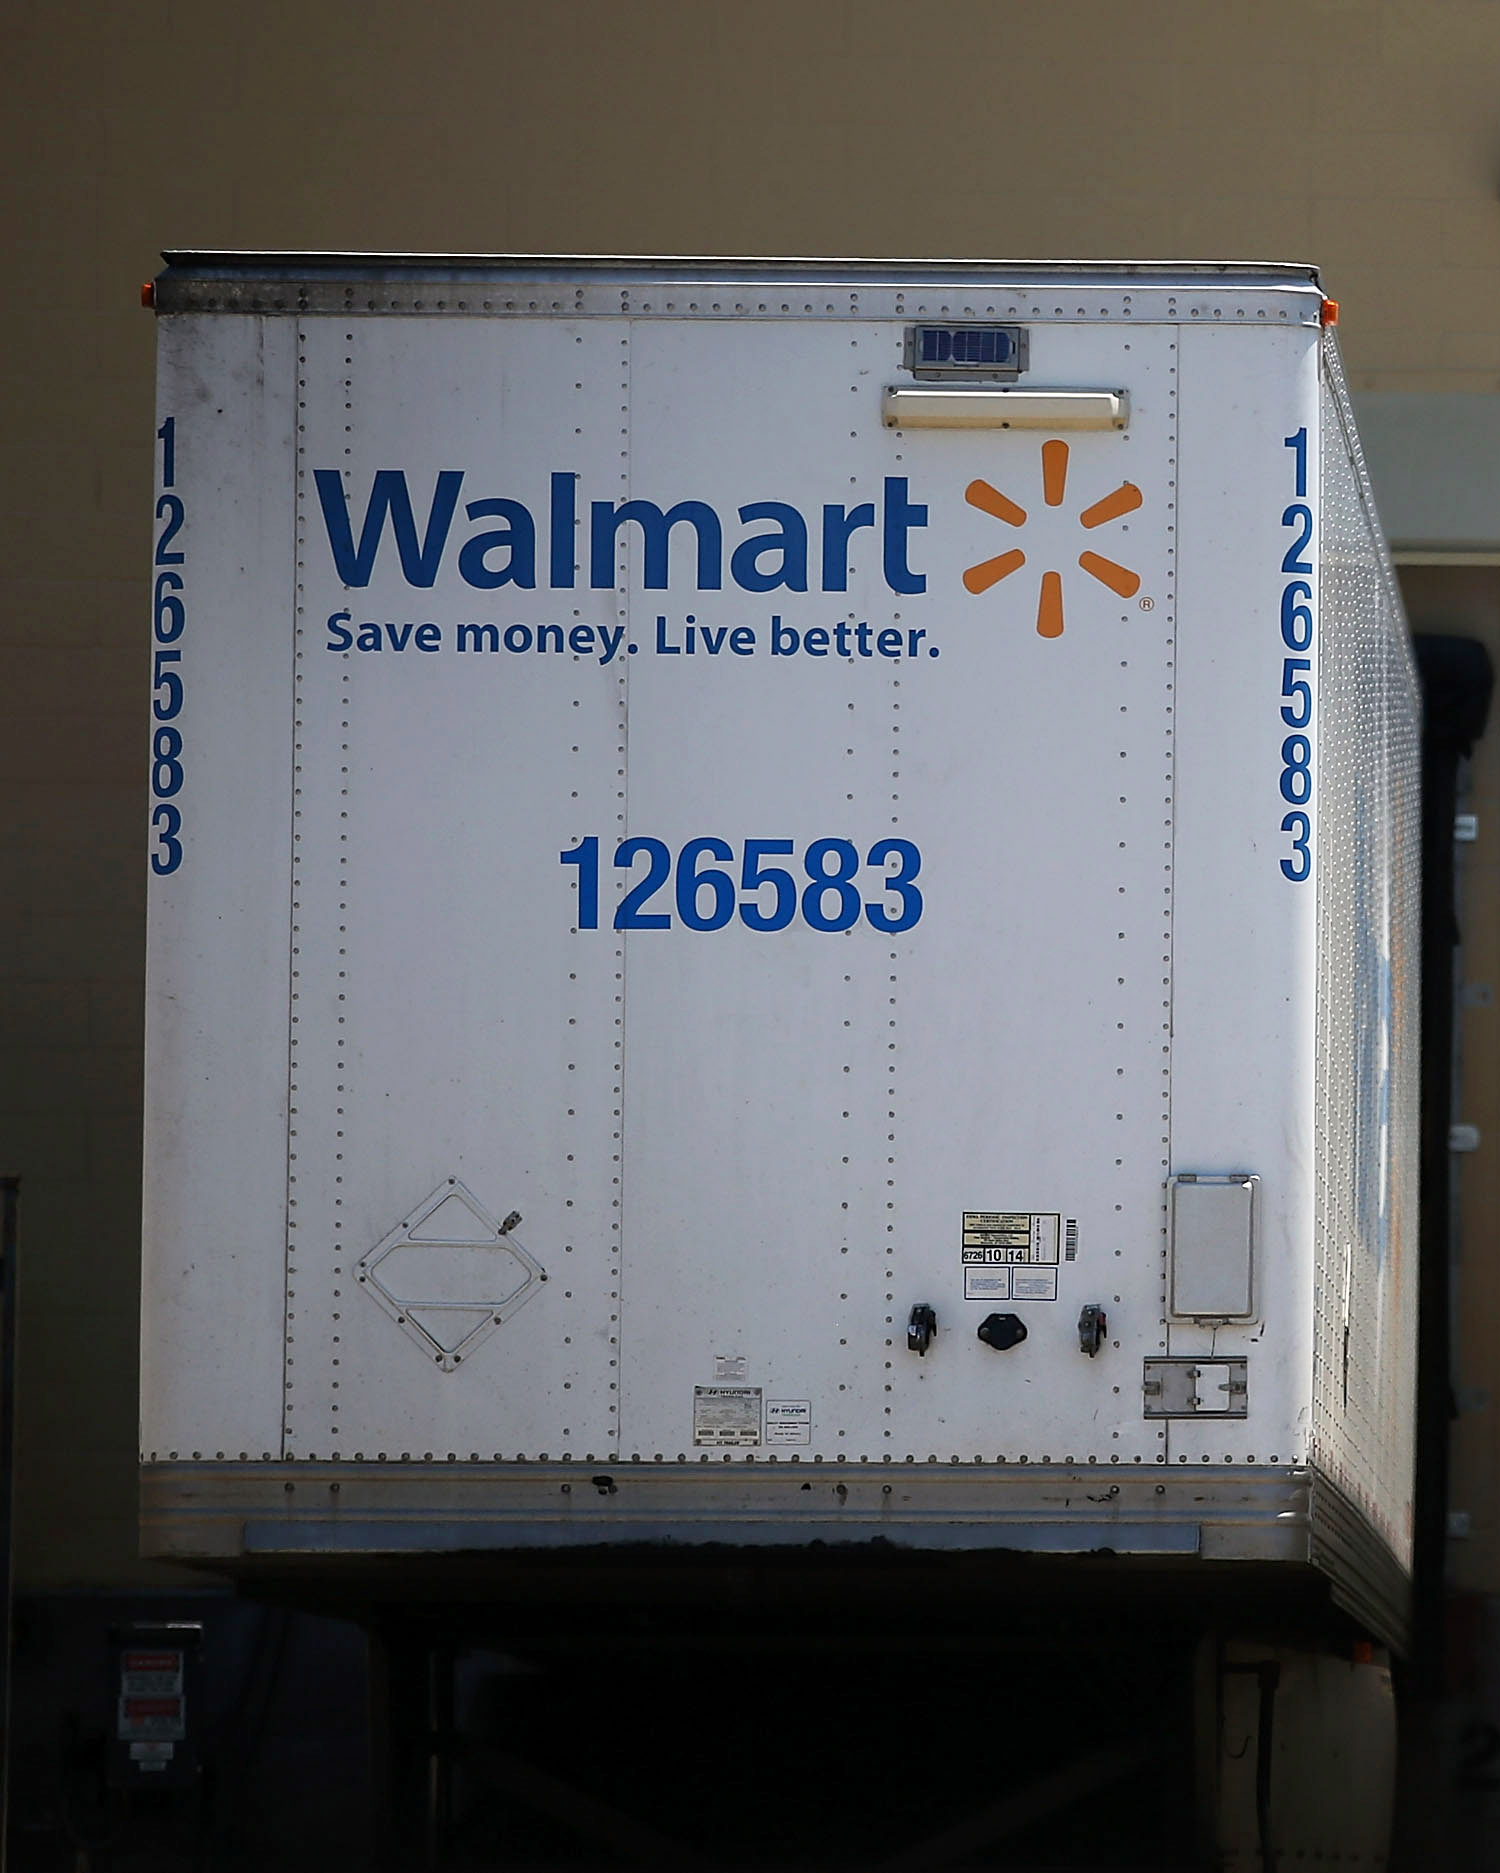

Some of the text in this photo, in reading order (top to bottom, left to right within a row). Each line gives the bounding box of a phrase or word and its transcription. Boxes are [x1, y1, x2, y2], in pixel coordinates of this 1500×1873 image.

[313, 469, 929, 594] Walmart
[151, 416, 187, 876] 126583
[326, 612, 941, 666] Save money. Live better.
[1280, 427, 1312, 882] 126583
[560, 836, 924, 933] 126583
[987, 1249, 1002, 1261] 10
[1008, 1250, 1024, 1262] 14
